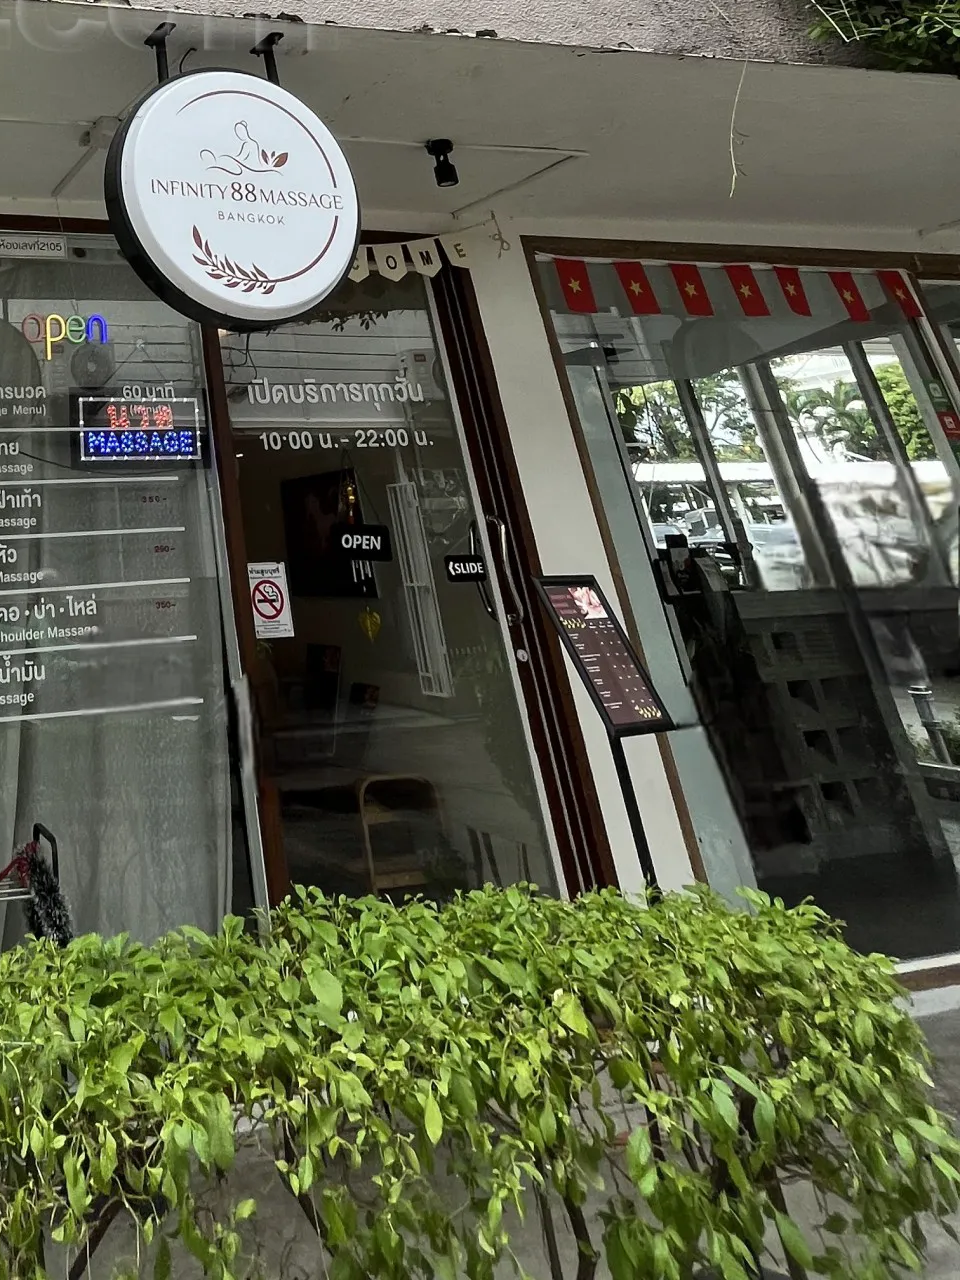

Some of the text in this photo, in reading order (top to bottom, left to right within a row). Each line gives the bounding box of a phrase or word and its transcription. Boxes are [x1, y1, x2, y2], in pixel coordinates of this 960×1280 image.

[151, 178, 344, 210] INFINITY 88 MASSAGE
[218, 211, 285, 225] BANGKOK
[22, 313, 108, 361] open
[122, 381, 175, 399] 60 นาที
[247, 376, 424, 411] เปิดบริการทุกวัน
[12, 404, 47, 417] Menu)
[88, 431, 193, 453] MASSAGE
[354, 429, 409, 448] 22:00
[415, 430, 434, 446] น.
[341, 534, 381, 550] OPEN
[455, 562, 484, 573] SLIDE
[34, 597, 55, 619] บ่า
[66, 593, 97, 617] ไหล่
